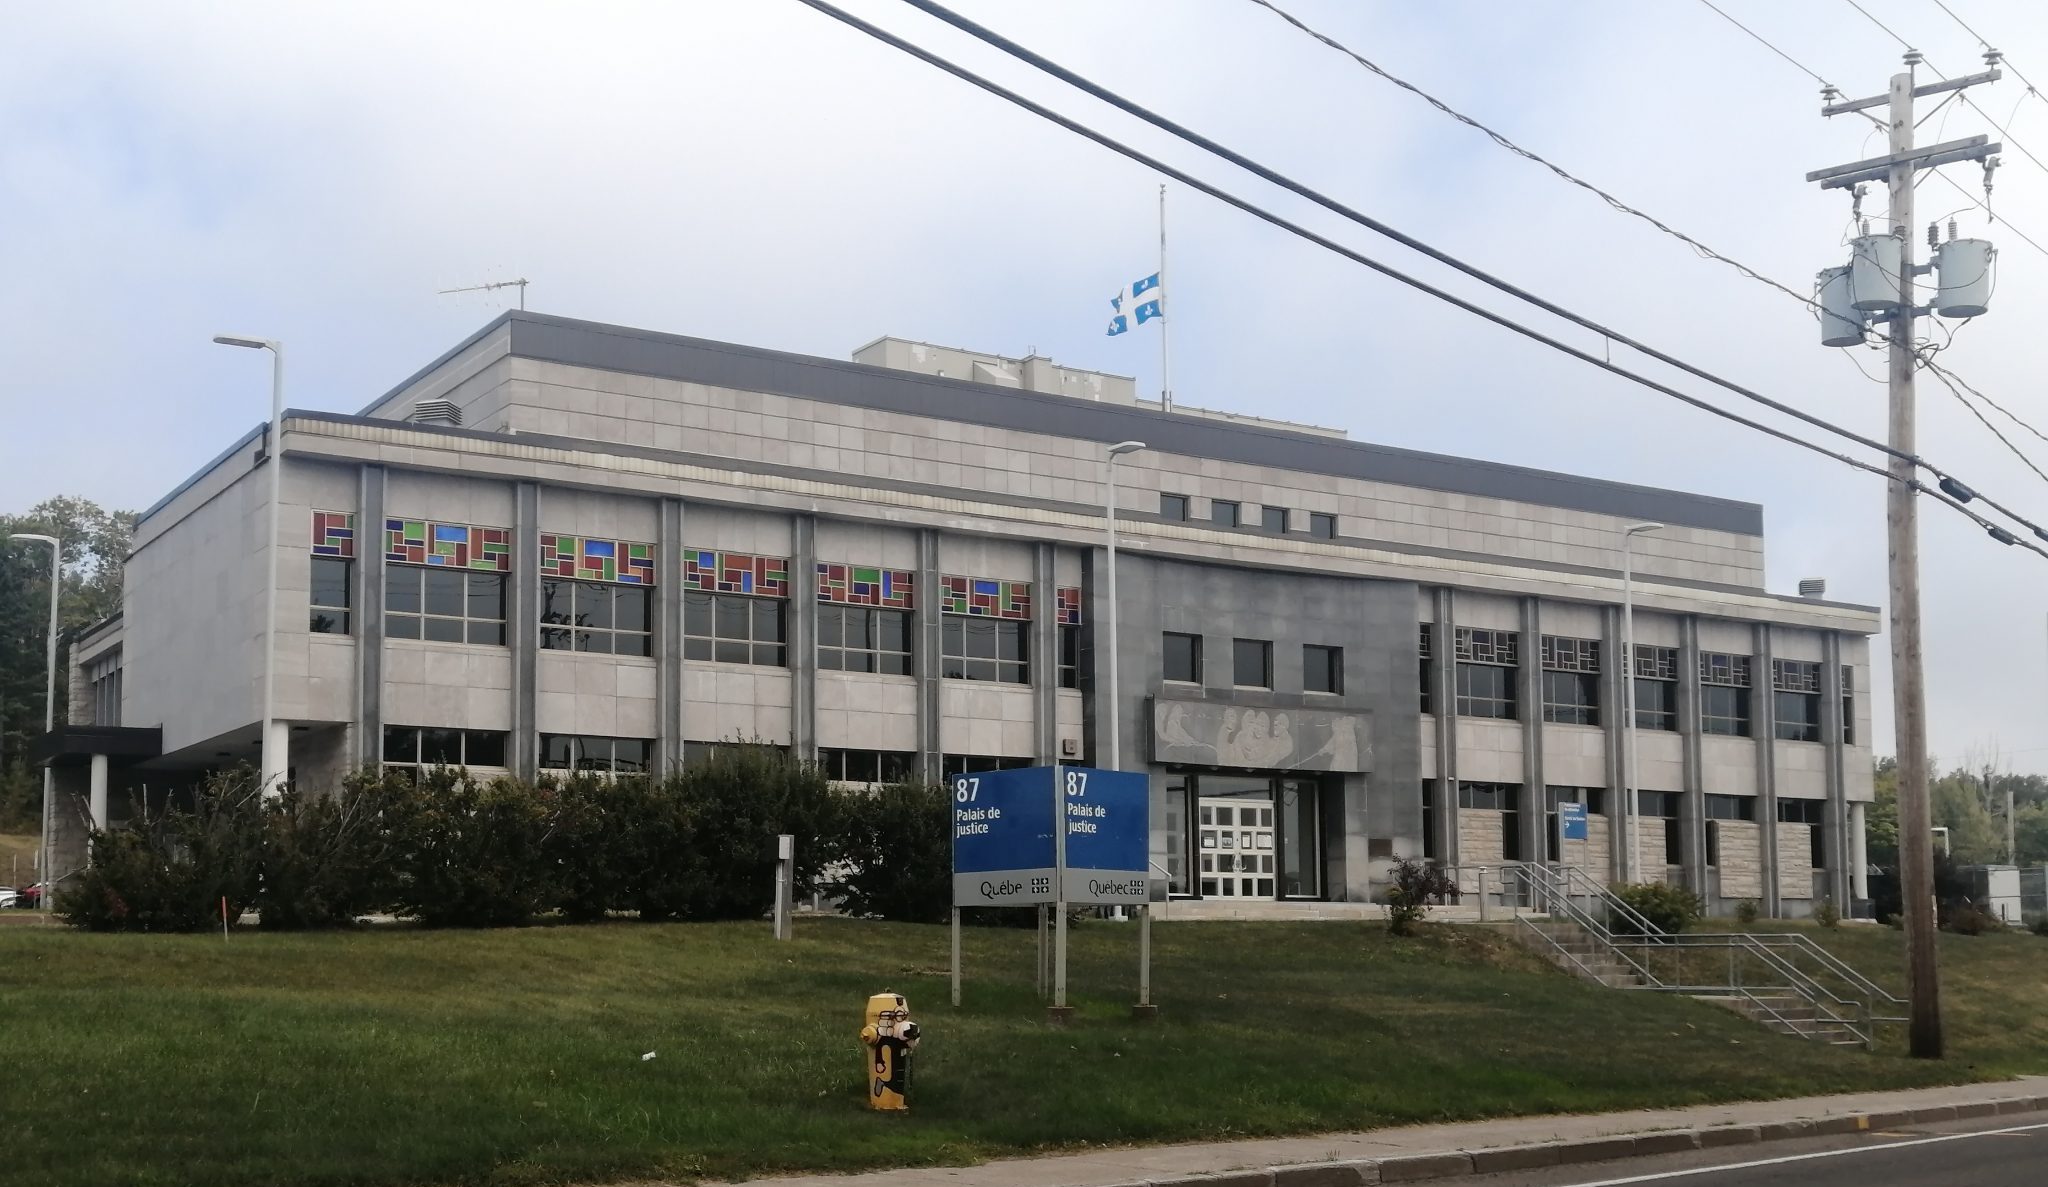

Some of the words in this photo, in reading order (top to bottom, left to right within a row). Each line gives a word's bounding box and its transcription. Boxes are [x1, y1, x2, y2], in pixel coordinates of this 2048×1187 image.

[956, 777, 980, 803] 87
[1067, 771, 1088, 797] 87
[956, 807, 985, 822] Palais
[987, 806, 1001, 819] de
[1067, 802, 1093, 817] Palais
[1094, 804, 1106, 818] de
[956, 822, 989, 839] justice
[1068, 818, 1097, 835] justice
[1088, 879, 1129, 898] Québec
